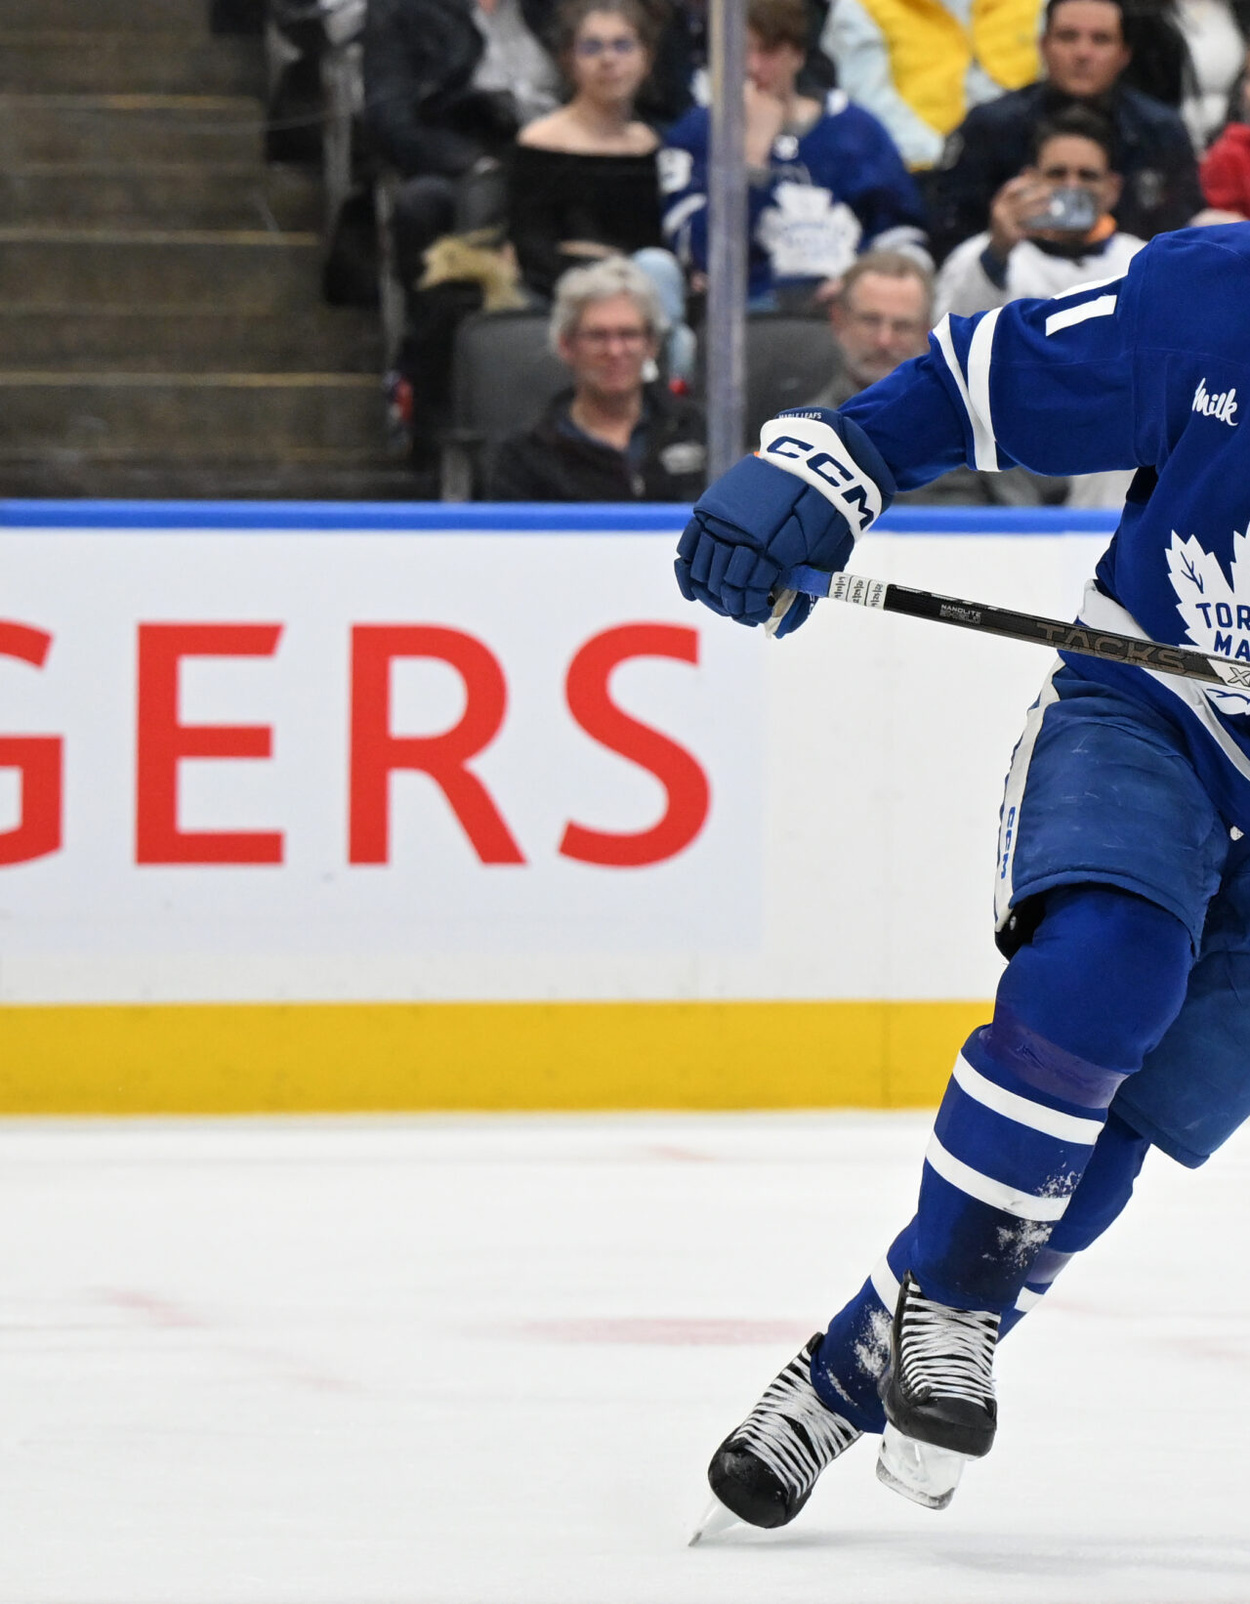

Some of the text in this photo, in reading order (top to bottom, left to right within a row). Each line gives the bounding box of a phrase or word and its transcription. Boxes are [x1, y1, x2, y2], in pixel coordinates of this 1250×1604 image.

[801, 412, 822, 420] LEAFS
[766, 435, 875, 532] CCM
[941, 604, 982, 617] NANOLITE
[1036, 622, 1186, 672] TACKS
[1000, 805, 1017, 880] CCM
